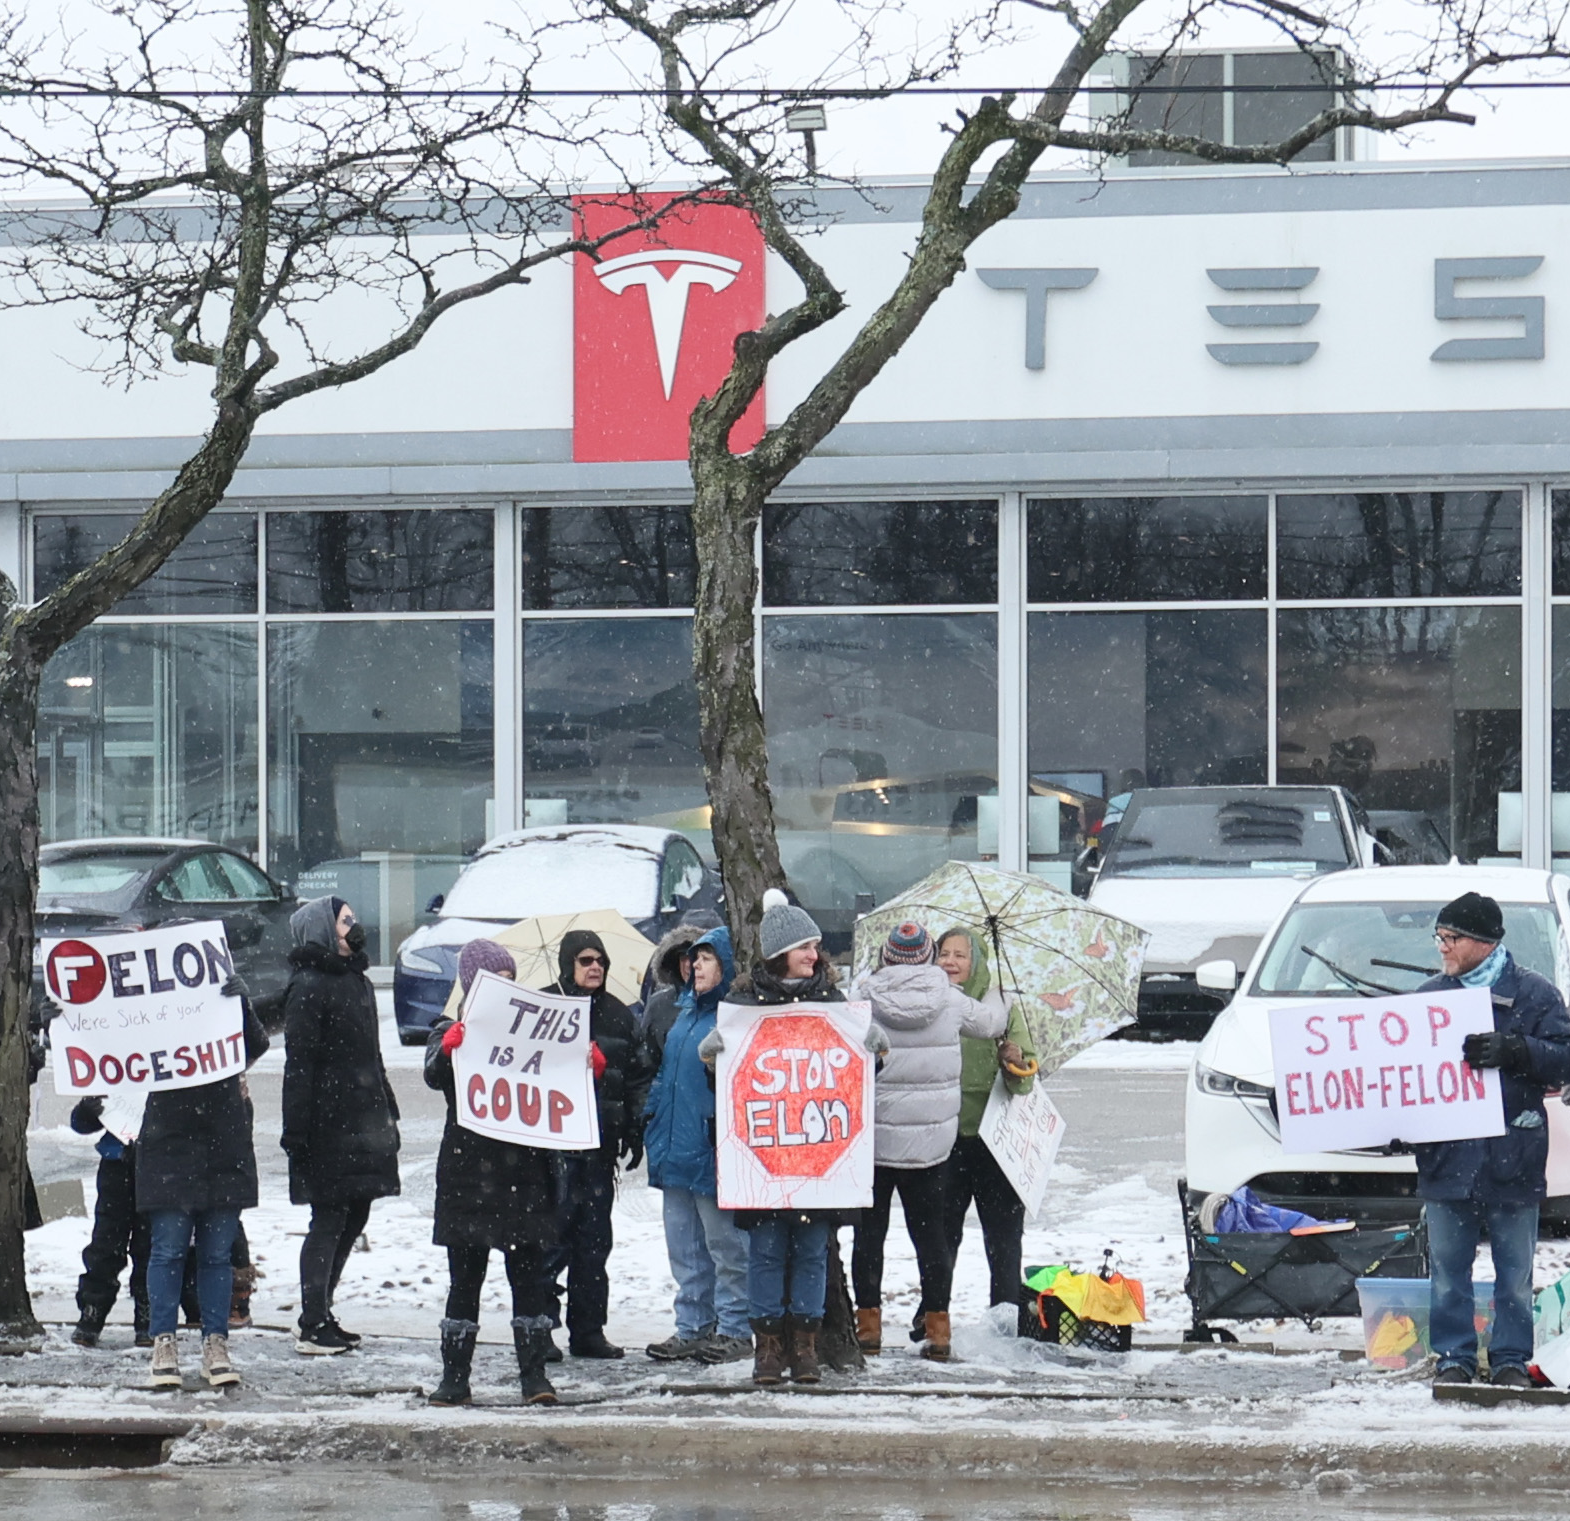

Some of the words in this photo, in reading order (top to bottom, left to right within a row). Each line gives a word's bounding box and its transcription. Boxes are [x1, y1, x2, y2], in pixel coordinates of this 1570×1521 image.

[297, 872, 339, 880] DELIVERY
[298, 882, 339, 890] CHECK-IN
[156, 1005, 169, 1021] of
[176, 1001, 204, 1020] your
[508, 997, 581, 1043] THIS
[1304, 1005, 1452, 1056] STOP
[65, 1031, 243, 1088] DOGESHIT
[488, 1045, 515, 1067] IS
[520, 1050, 544, 1075] A
[751, 1047, 851, 1096] STOP
[467, 1073, 575, 1134] COUP
[1284, 1060, 1487, 1116] ELON-FELON
